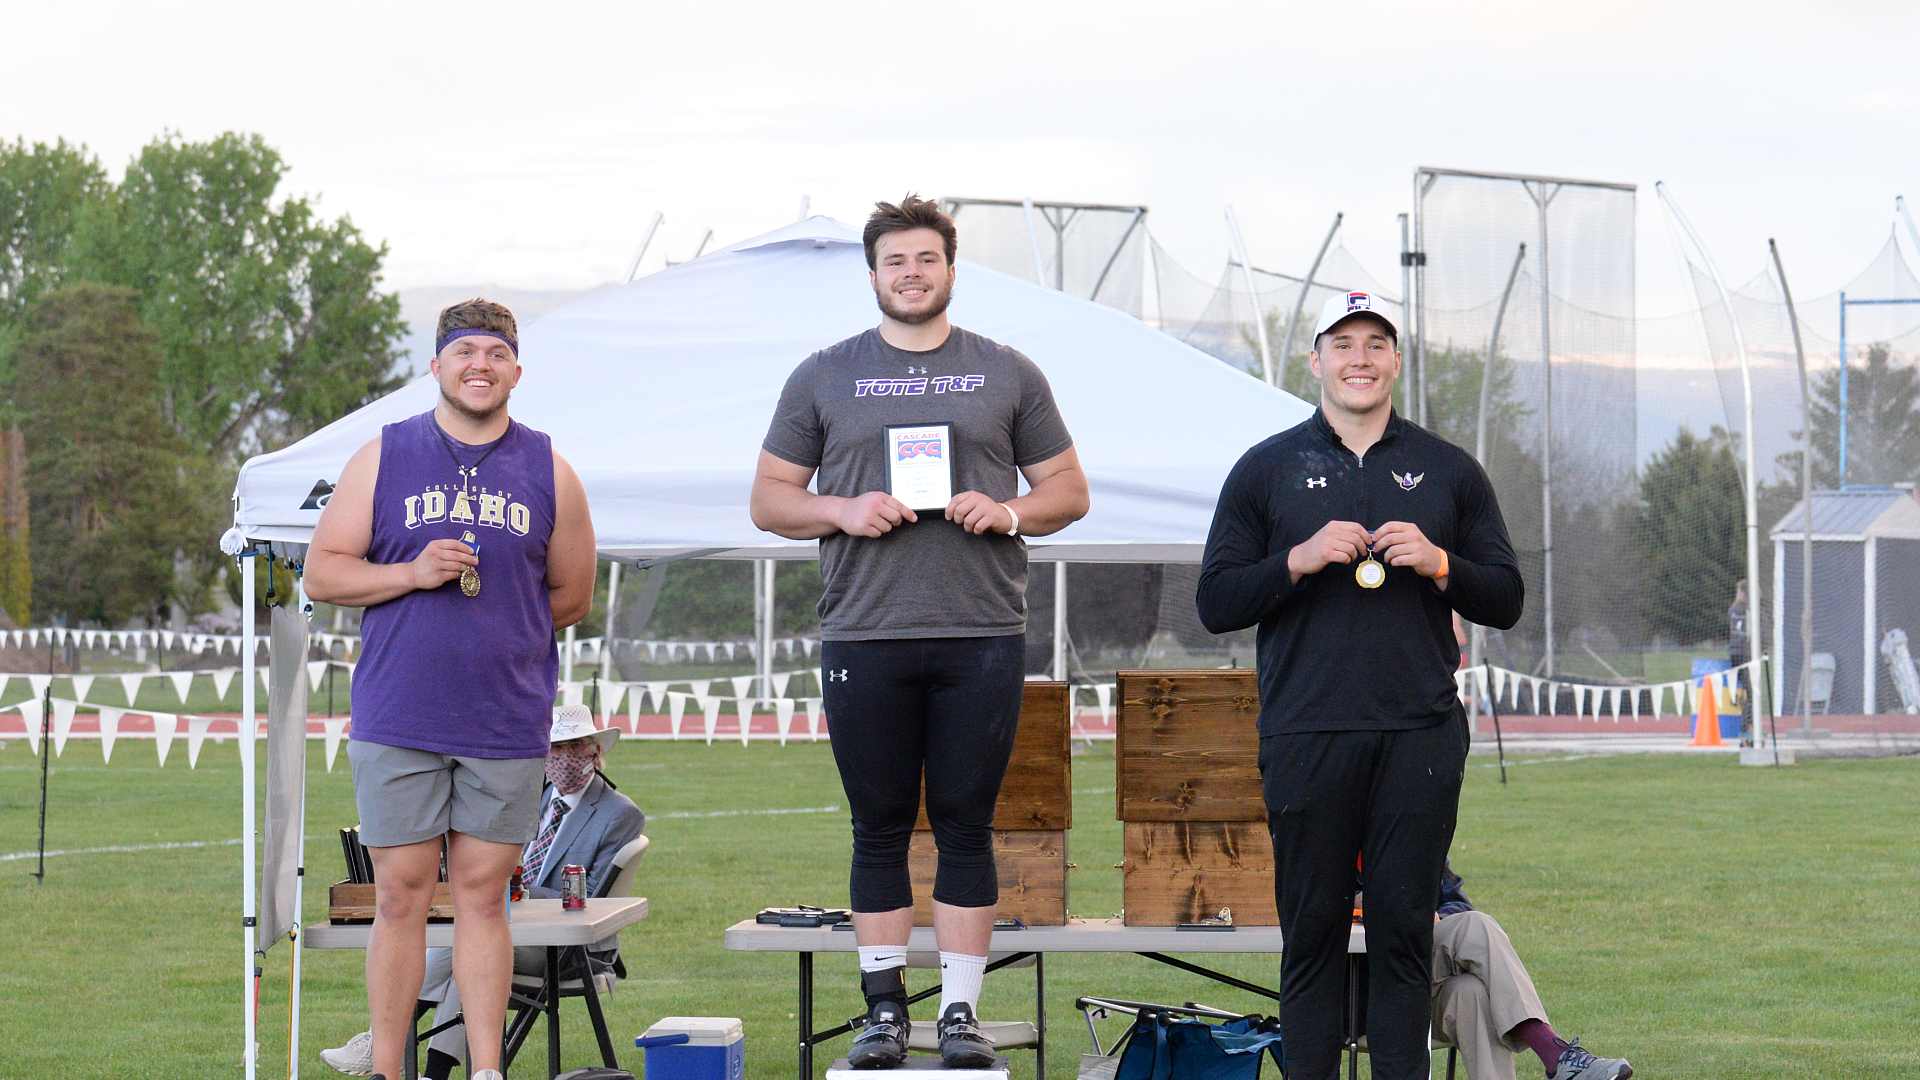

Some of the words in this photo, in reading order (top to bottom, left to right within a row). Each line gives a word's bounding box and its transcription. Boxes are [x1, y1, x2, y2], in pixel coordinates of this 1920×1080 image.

[855, 378, 928, 397] YOTE
[931, 375, 985, 393] T&F
[498, 490, 512, 499] OF
[405, 491, 530, 536] IDAHO
